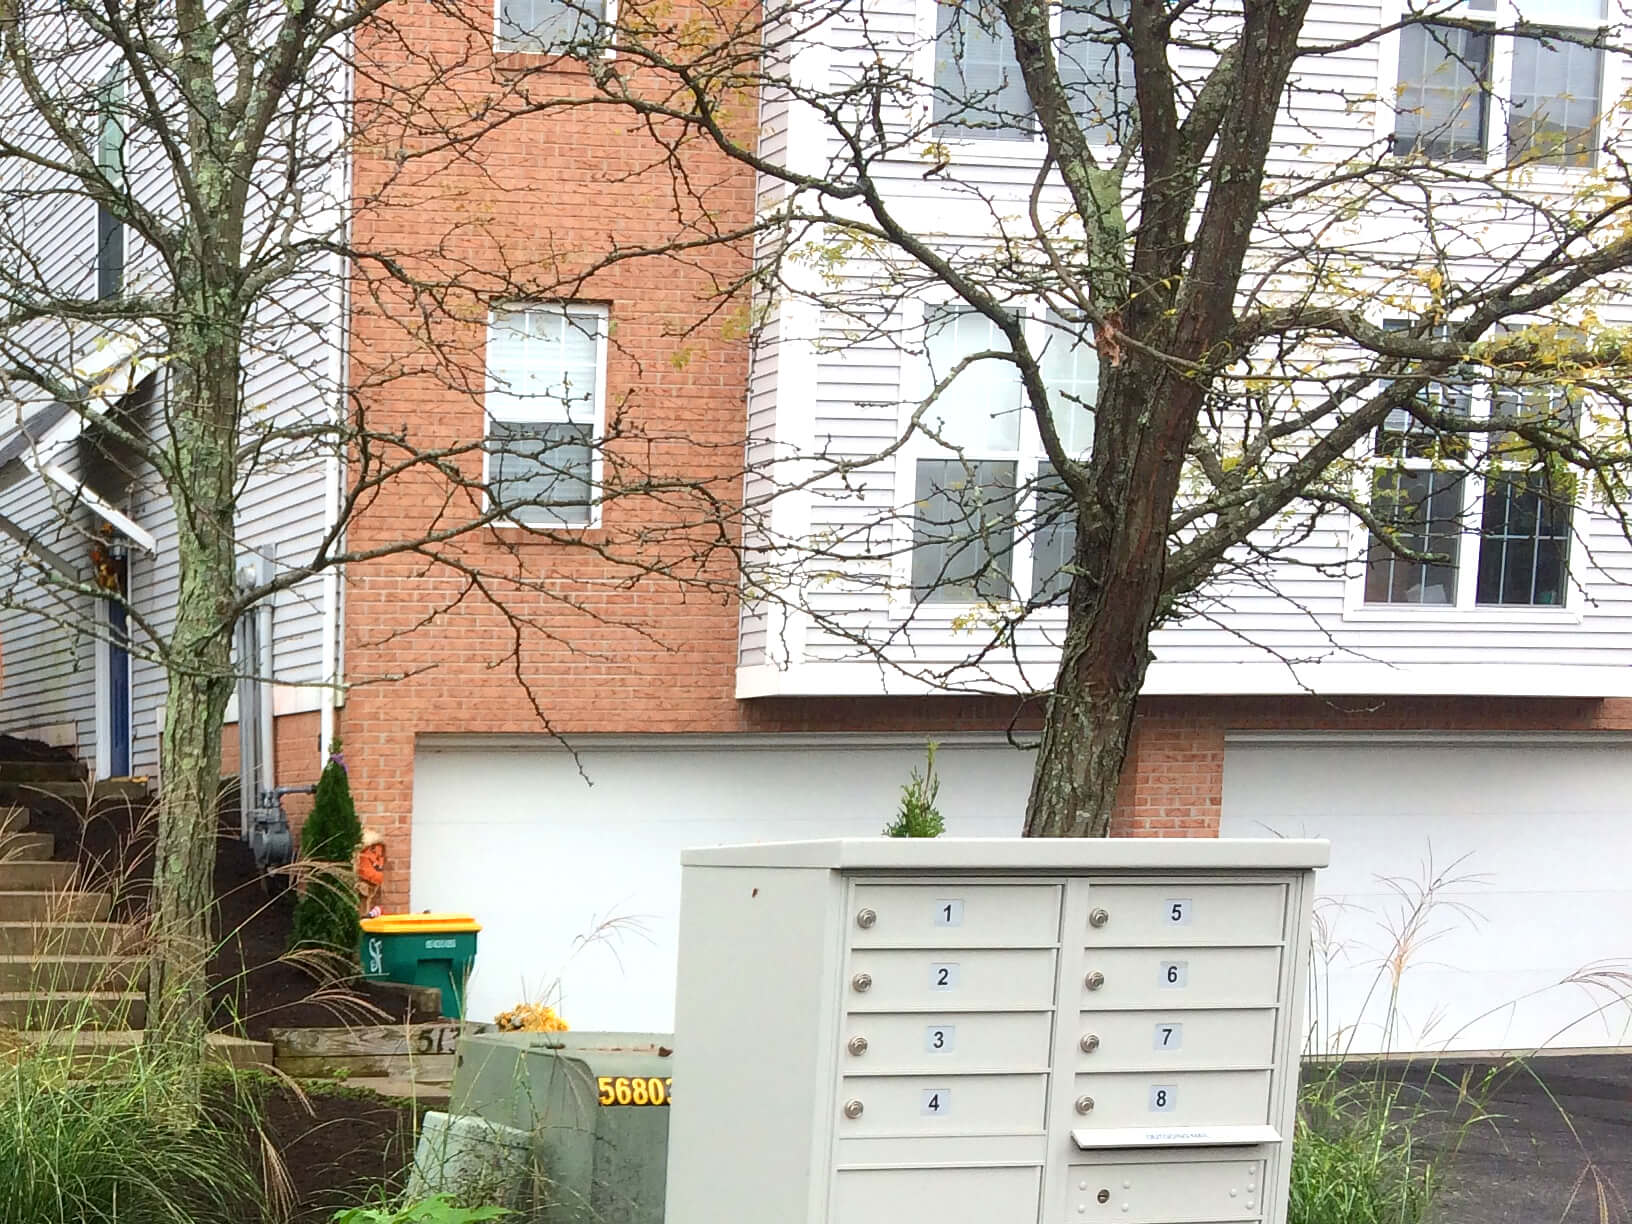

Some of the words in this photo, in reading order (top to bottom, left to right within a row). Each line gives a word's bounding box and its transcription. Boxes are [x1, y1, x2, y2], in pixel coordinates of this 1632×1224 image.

[943, 904, 952, 922] 1
[1171, 903, 1182, 922] 5
[937, 968, 949, 986] 2
[1167, 965, 1178, 983] 6
[416, 1027, 464, 1055] 513
[933, 1031, 944, 1049] 3
[1162, 1028, 1173, 1046] 7
[928, 1093, 940, 1112] 4
[1156, 1090, 1167, 1108] 8
